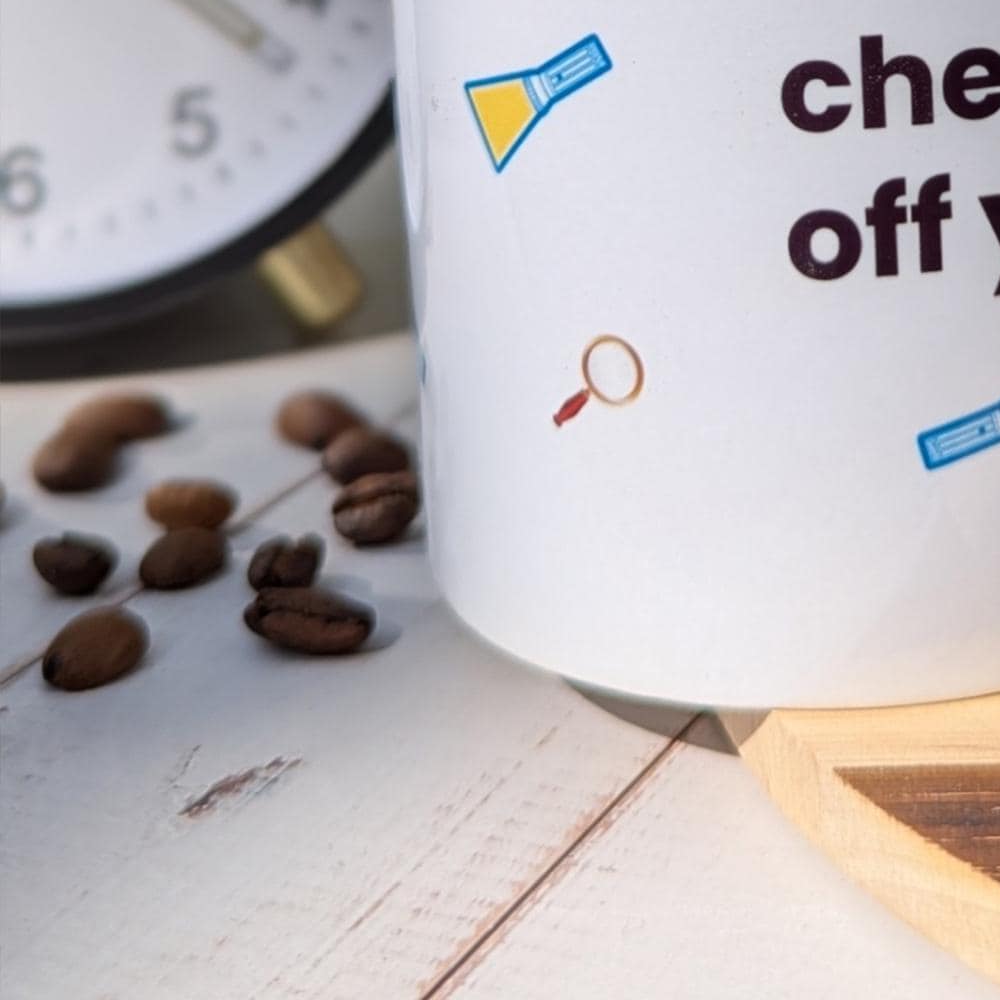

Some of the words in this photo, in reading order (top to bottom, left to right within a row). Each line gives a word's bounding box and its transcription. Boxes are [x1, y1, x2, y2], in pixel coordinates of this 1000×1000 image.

[171, 84, 220, 158] 5
[0, 145, 47, 216] 6
[788, 173, 952, 281] off
